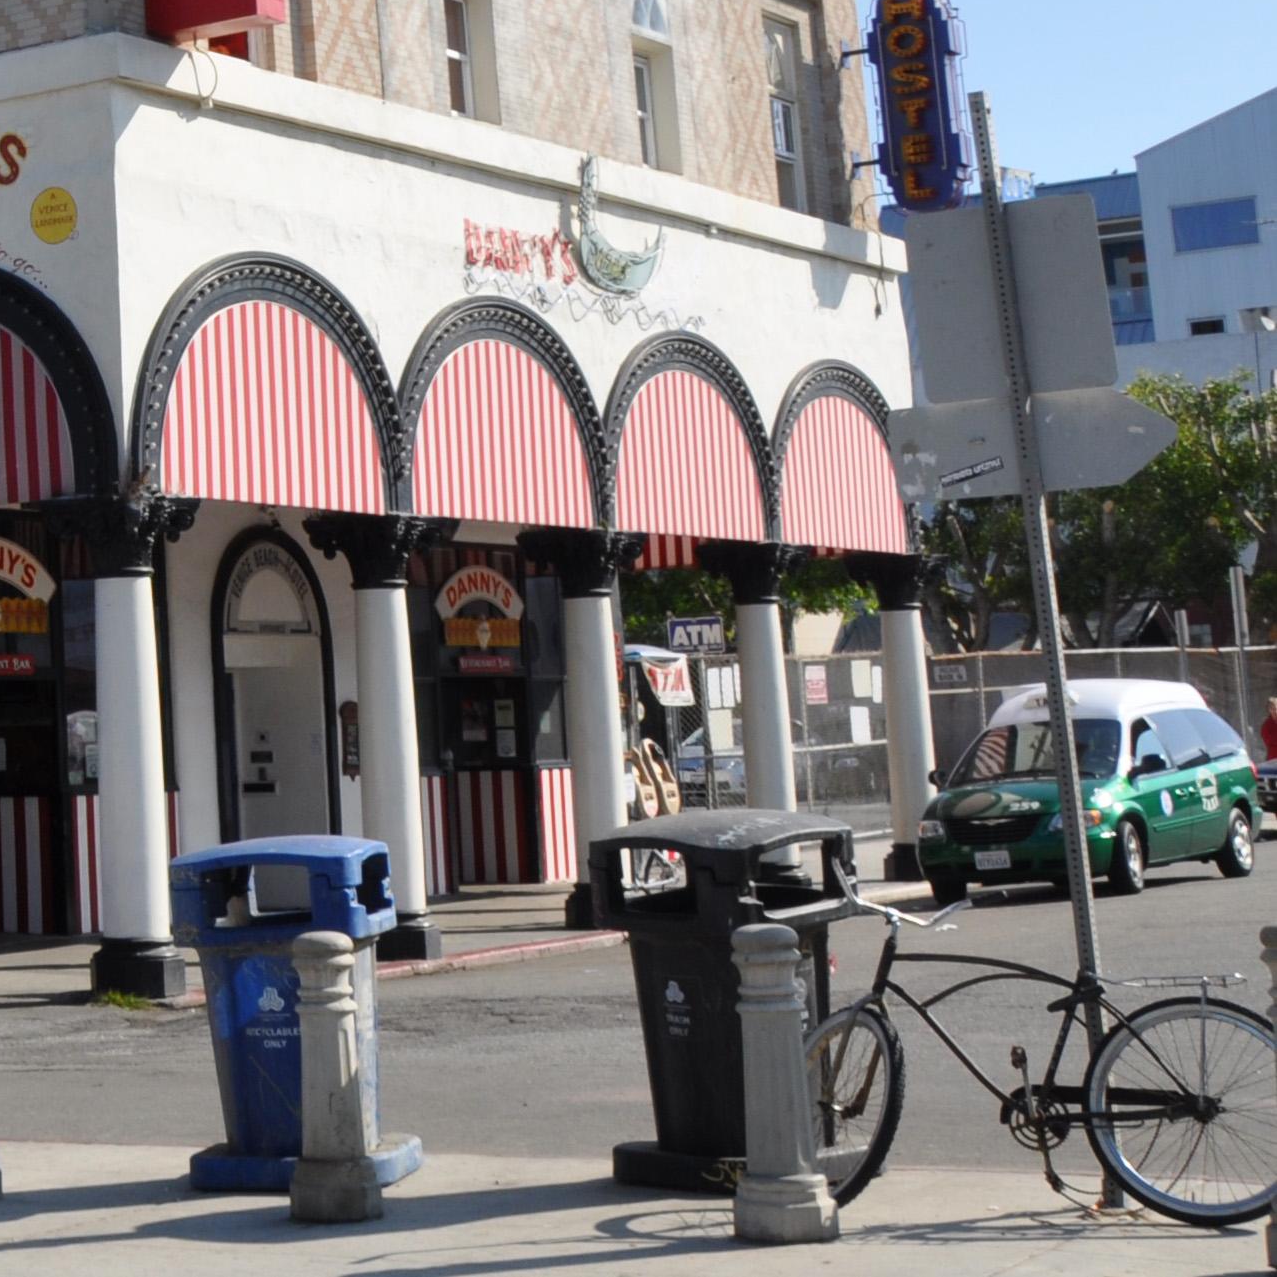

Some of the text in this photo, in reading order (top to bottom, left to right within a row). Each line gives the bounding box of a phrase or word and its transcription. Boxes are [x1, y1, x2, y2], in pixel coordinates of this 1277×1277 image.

[445, 571, 513, 610] DANNY'S
[672, 624, 722, 648] ATM
[12, 656, 32, 671] BAR
[1009, 800, 1042, 812] 259
[263, 1039, 288, 1049] ONLY
